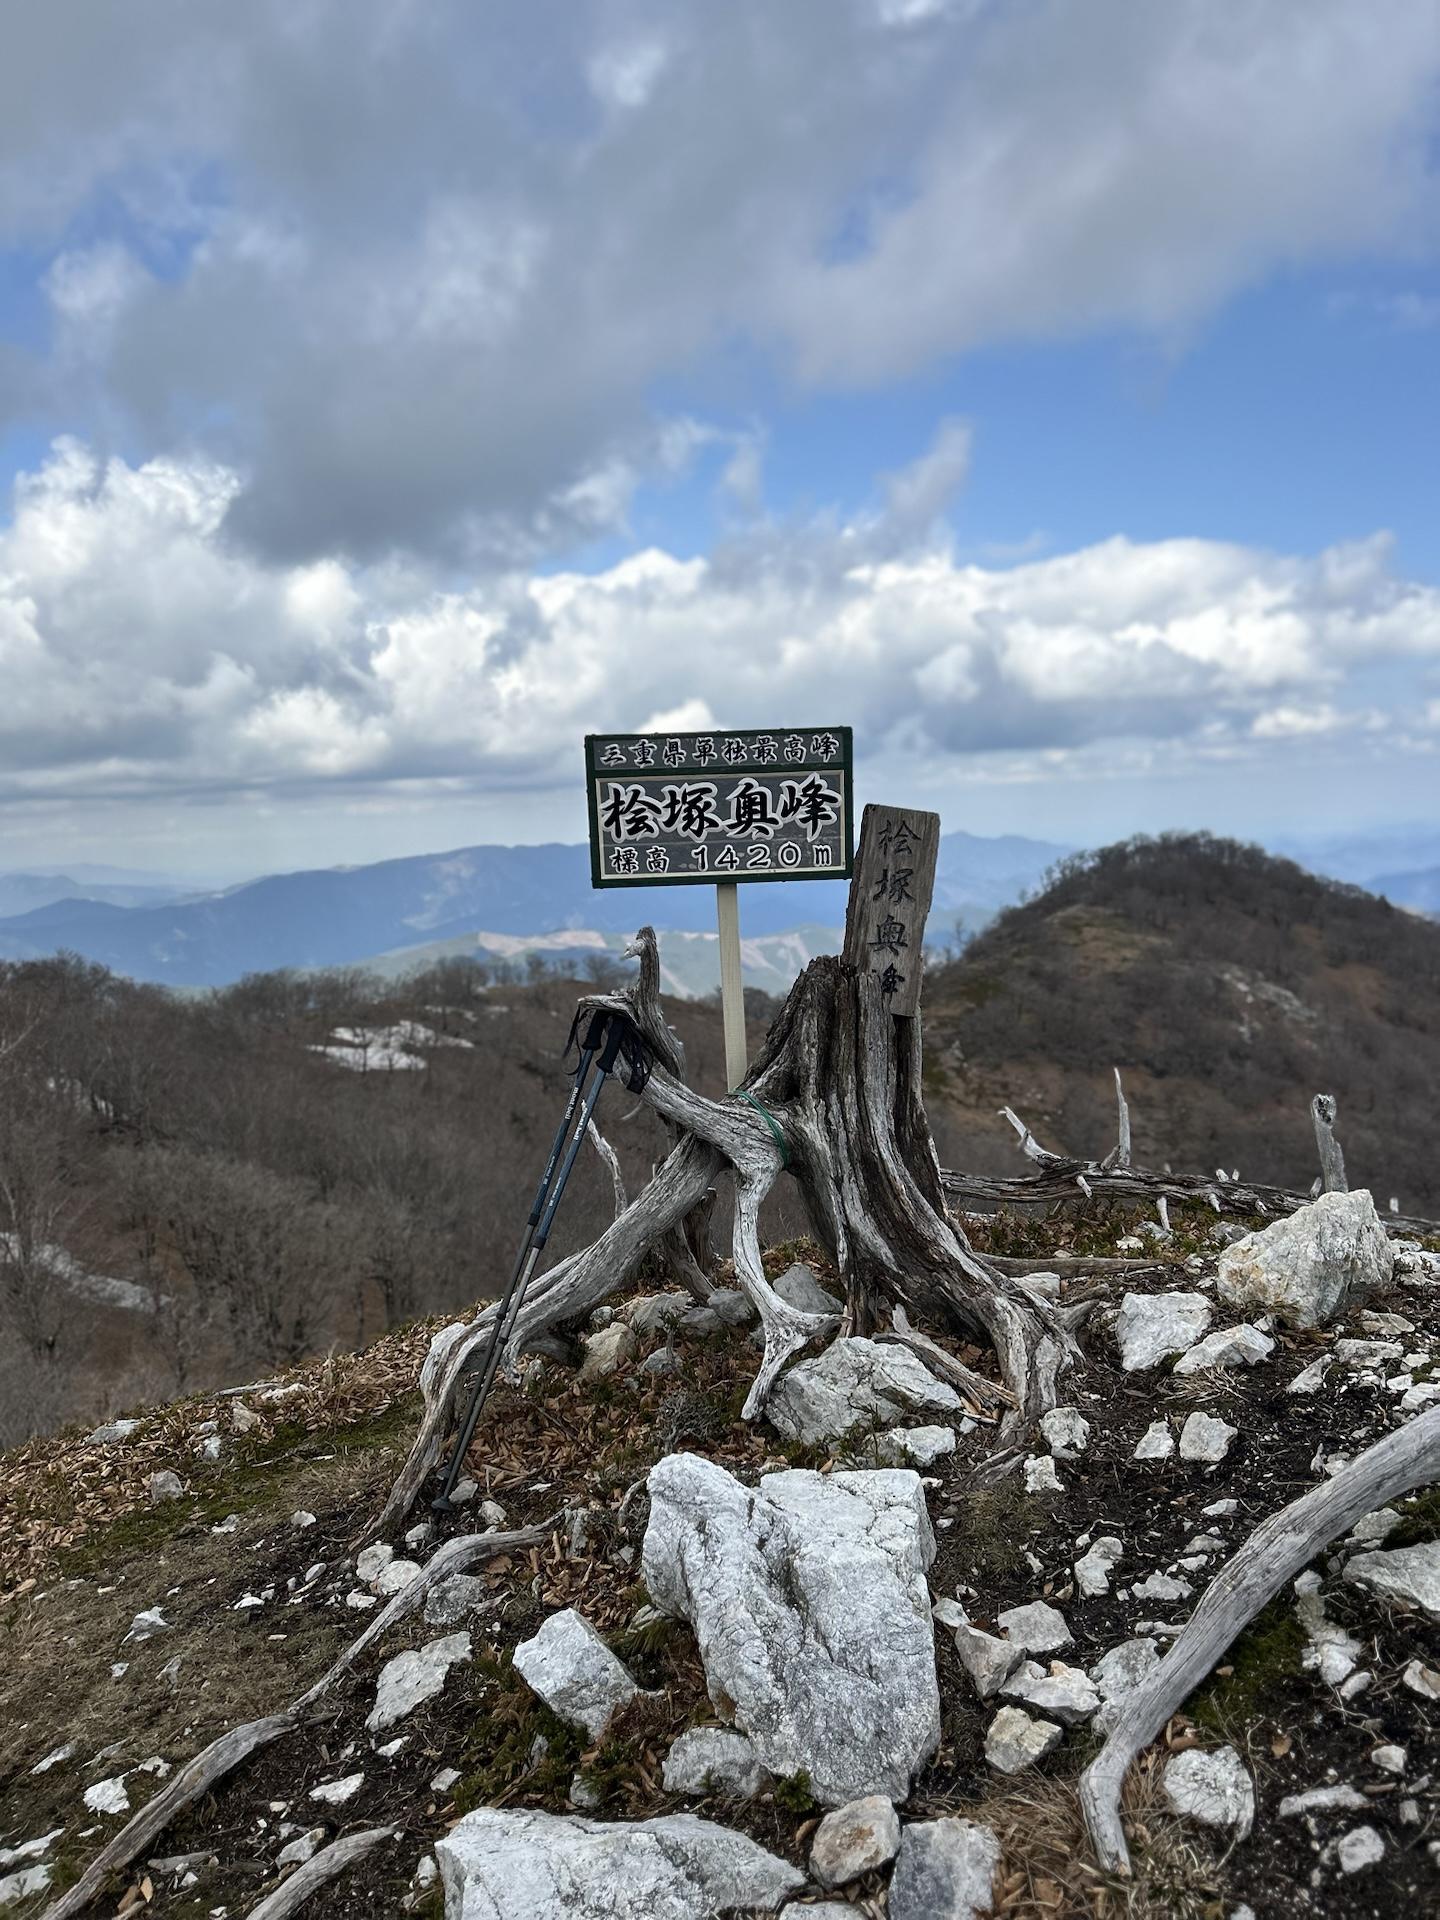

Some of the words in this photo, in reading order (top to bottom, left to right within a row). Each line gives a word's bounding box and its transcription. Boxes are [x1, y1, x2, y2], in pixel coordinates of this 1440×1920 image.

[600, 732, 840, 768] 三重県単独最高峰
[601, 772, 841, 842] 桧塚奥峰
[610, 846, 670, 873] 標高
